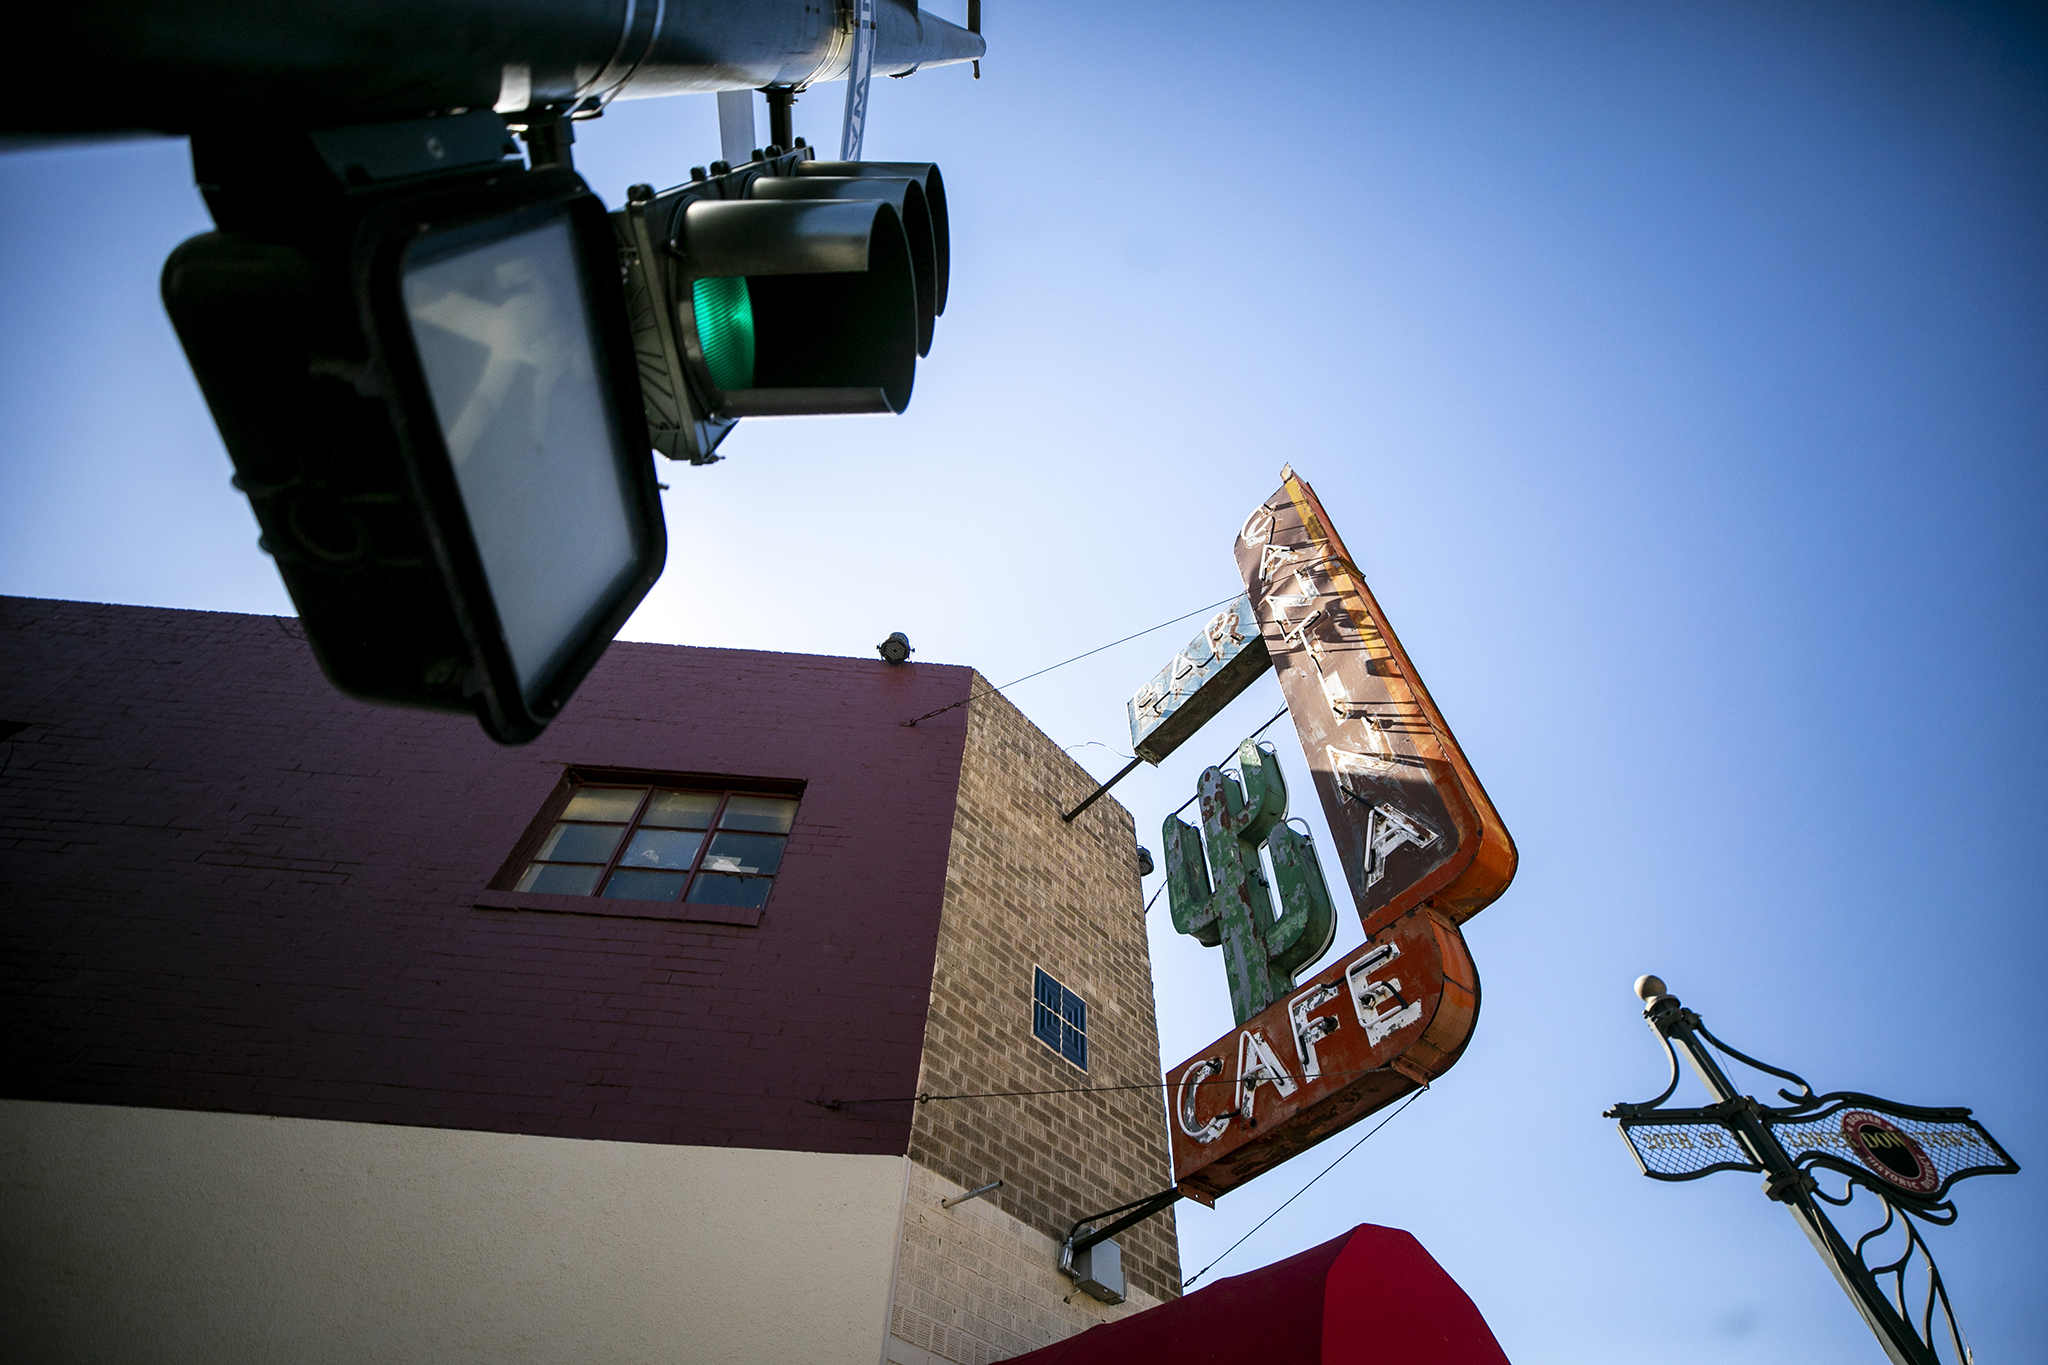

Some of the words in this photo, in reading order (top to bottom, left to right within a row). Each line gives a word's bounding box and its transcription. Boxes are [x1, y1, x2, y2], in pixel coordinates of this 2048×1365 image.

[849, 77, 866, 161] WA
[1133, 612, 1246, 736] BAR
[1241, 502, 1440, 887] CANTINA
[1177, 941, 1423, 1144] CAFE
[1642, 1133, 1694, 1149] 20TH
[1700, 1132, 1729, 1149] ST
[1785, 1132, 1860, 1149] LOWER
[1859, 1132, 1982, 1149] DOWNTOWN
[1846, 1113, 1882, 1126] DENVER
[1866, 1155, 1920, 1190] HISTORIC
[1918, 1154, 1936, 1190] DISTRICT
